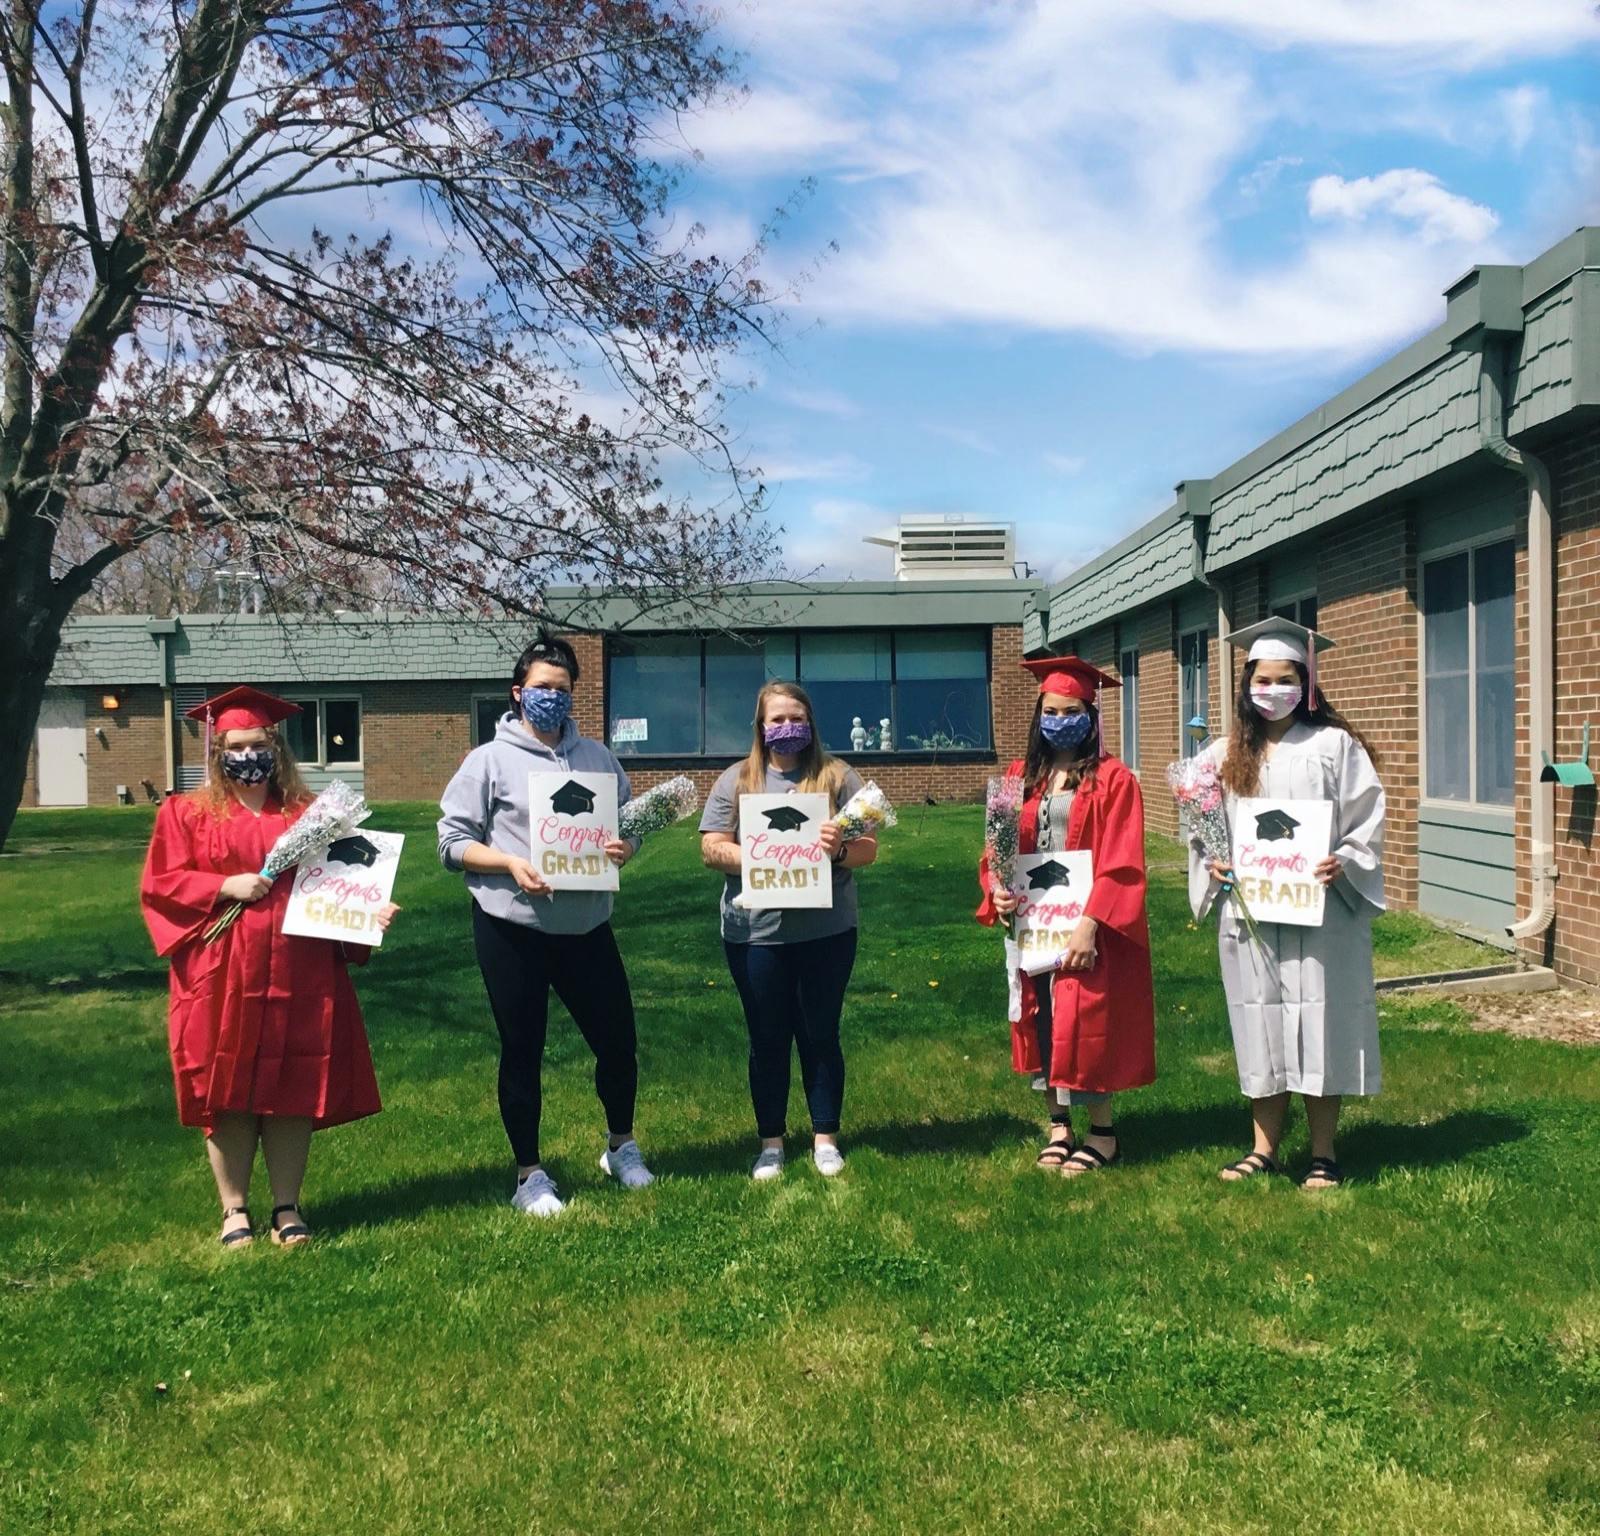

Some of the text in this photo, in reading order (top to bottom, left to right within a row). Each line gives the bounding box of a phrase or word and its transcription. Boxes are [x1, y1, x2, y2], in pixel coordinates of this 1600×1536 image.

[537, 815, 612, 853] Congrats
[746, 833, 822, 868] Congrats
[1239, 844, 1307, 877] Congrats
[300, 867, 382, 907] Congrats
[1015, 895, 1082, 925] Congrats
